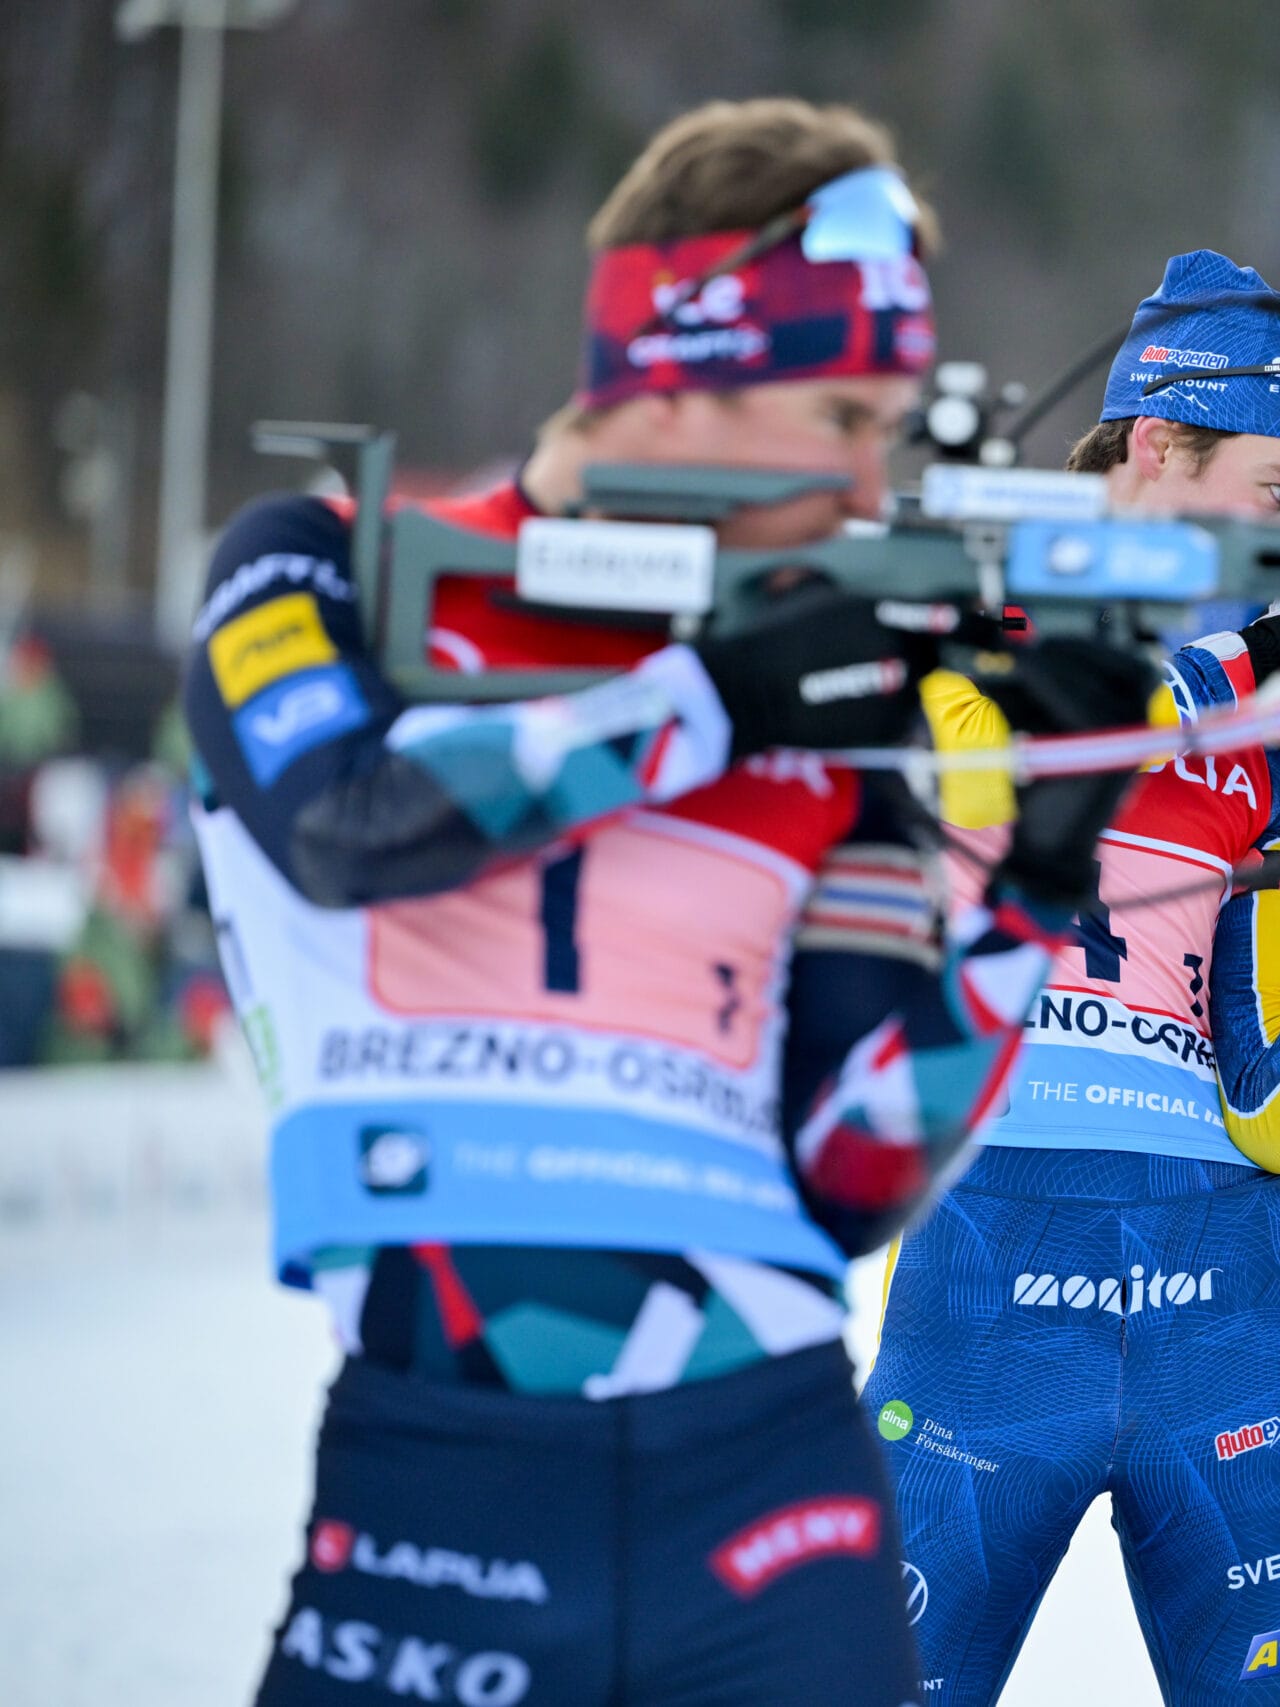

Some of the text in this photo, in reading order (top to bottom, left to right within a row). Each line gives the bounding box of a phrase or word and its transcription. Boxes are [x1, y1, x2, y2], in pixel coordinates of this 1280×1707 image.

[1140, 346, 1229, 369] Autoexperten
[1028, 1081, 1078, 1102] THE
[1085, 1085, 1200, 1119] OFFICIAL
[1013, 1264, 1224, 1316] monitor
[881, 1409, 909, 1431] dina
[921, 1418, 953, 1440] Dina
[915, 1433, 1000, 1473] Försäkringar
[281, 1605, 532, 1707] ASKO
